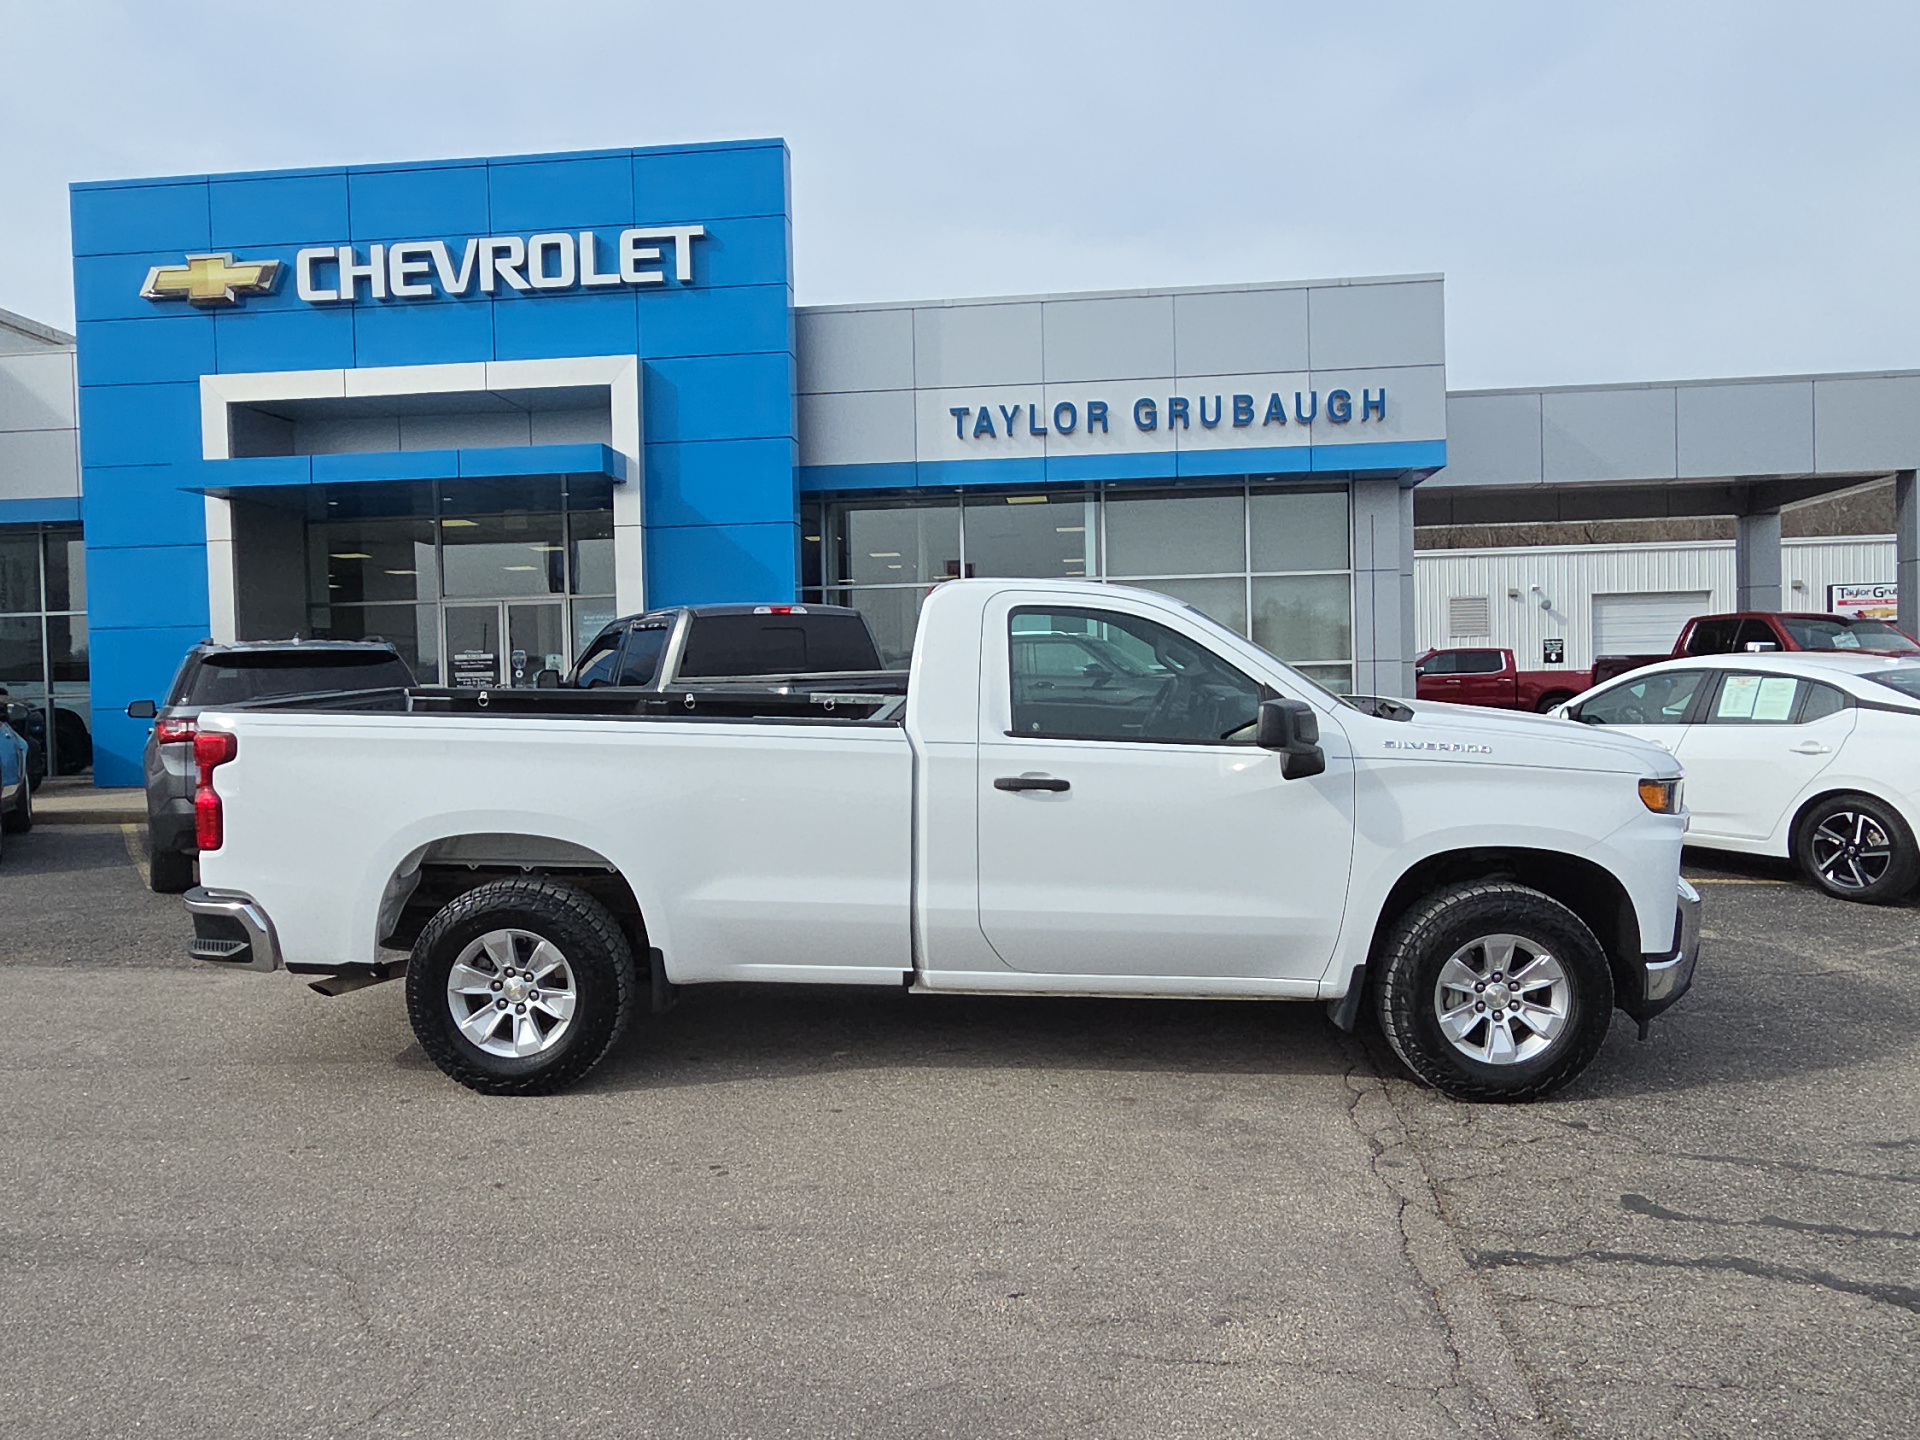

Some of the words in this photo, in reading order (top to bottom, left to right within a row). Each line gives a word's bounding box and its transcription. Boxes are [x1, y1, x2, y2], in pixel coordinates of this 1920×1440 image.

[297, 225, 705, 301] CHEVROLET
[949, 400, 1109, 439] TAYLOR
[1133, 387, 1387, 432] GRUBAUGH
[1837, 587, 1871, 599] Taylor
[1382, 740, 1493, 754] SILVERADO
